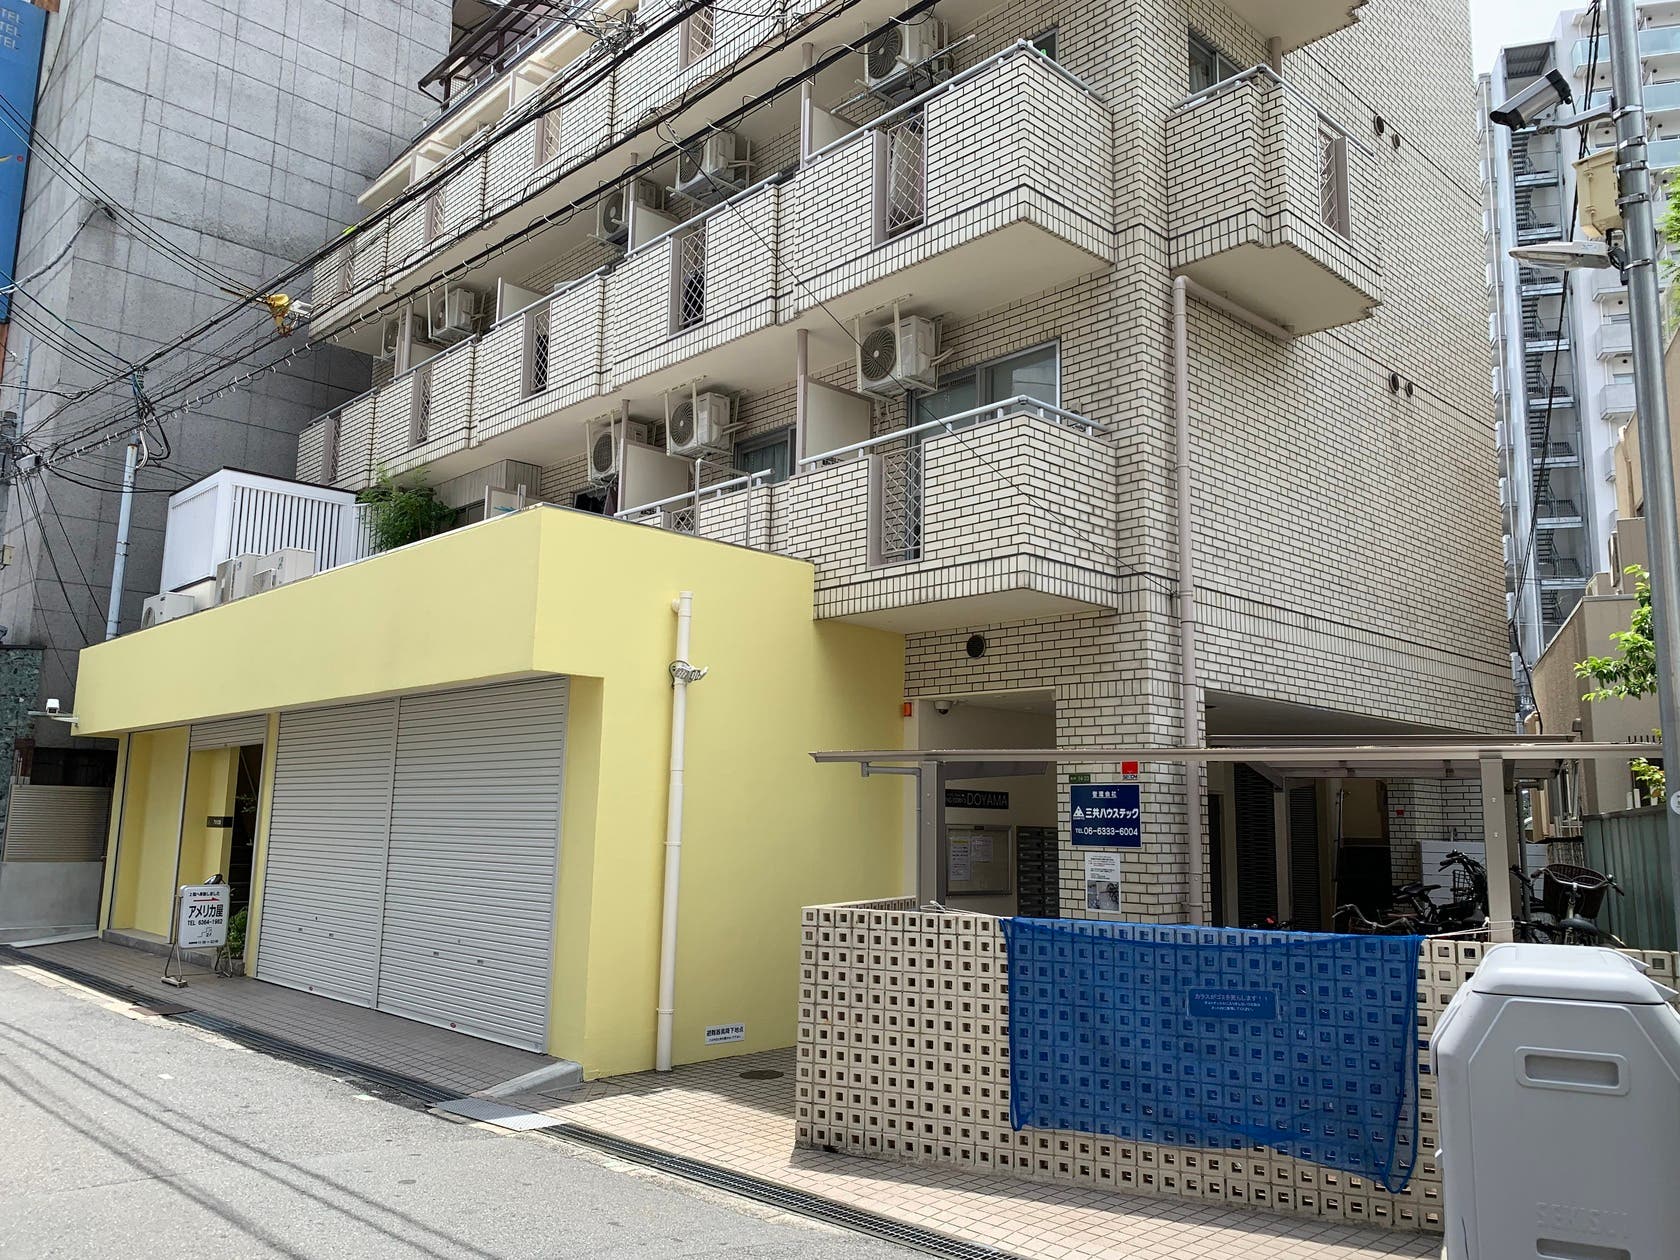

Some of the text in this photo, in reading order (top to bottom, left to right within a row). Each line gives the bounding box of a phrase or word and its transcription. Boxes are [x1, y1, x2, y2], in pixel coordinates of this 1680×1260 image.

[967, 793, 1008, 806] DOYAMA
[1085, 807, 1139, 819] 三共ハウステック
[1084, 827, 1138, 836] 06-6333-6004
[188, 904, 224, 918] アメリカ屋
